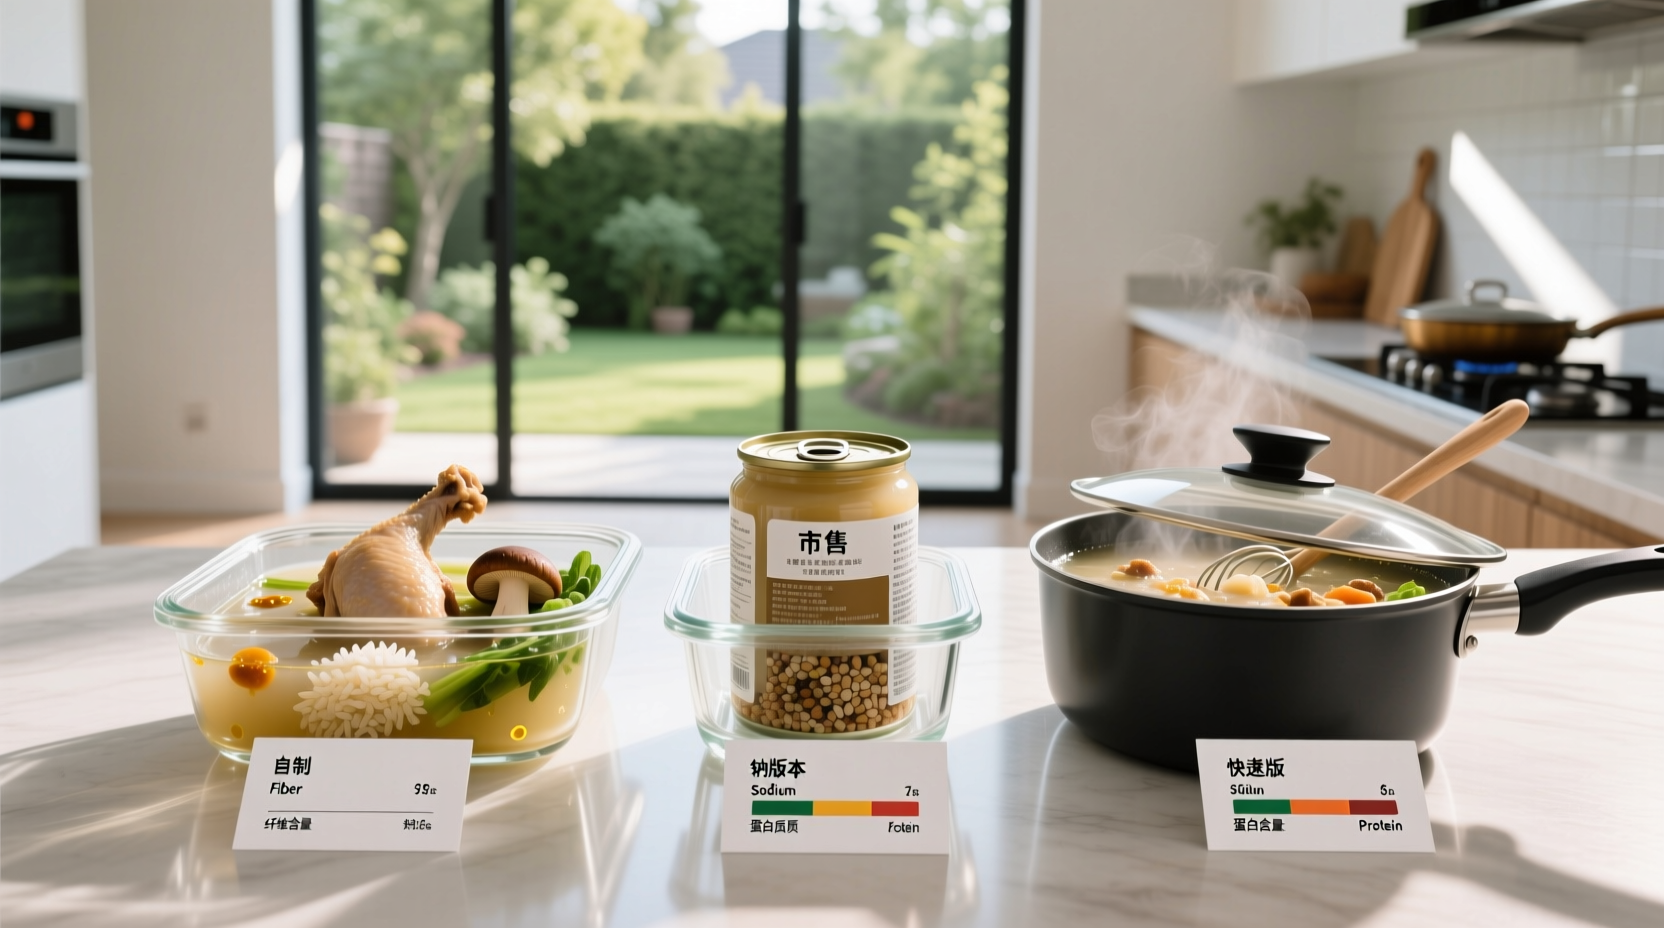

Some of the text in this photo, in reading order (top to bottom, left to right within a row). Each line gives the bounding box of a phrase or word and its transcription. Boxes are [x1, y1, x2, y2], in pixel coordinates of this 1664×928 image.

[798, 529, 848, 556] 市售
[274, 755, 312, 776] 自制
[269, 781, 303, 795] Fiber
[751, 783, 796, 796] Sodium
[1358, 819, 1403, 832] Protein
